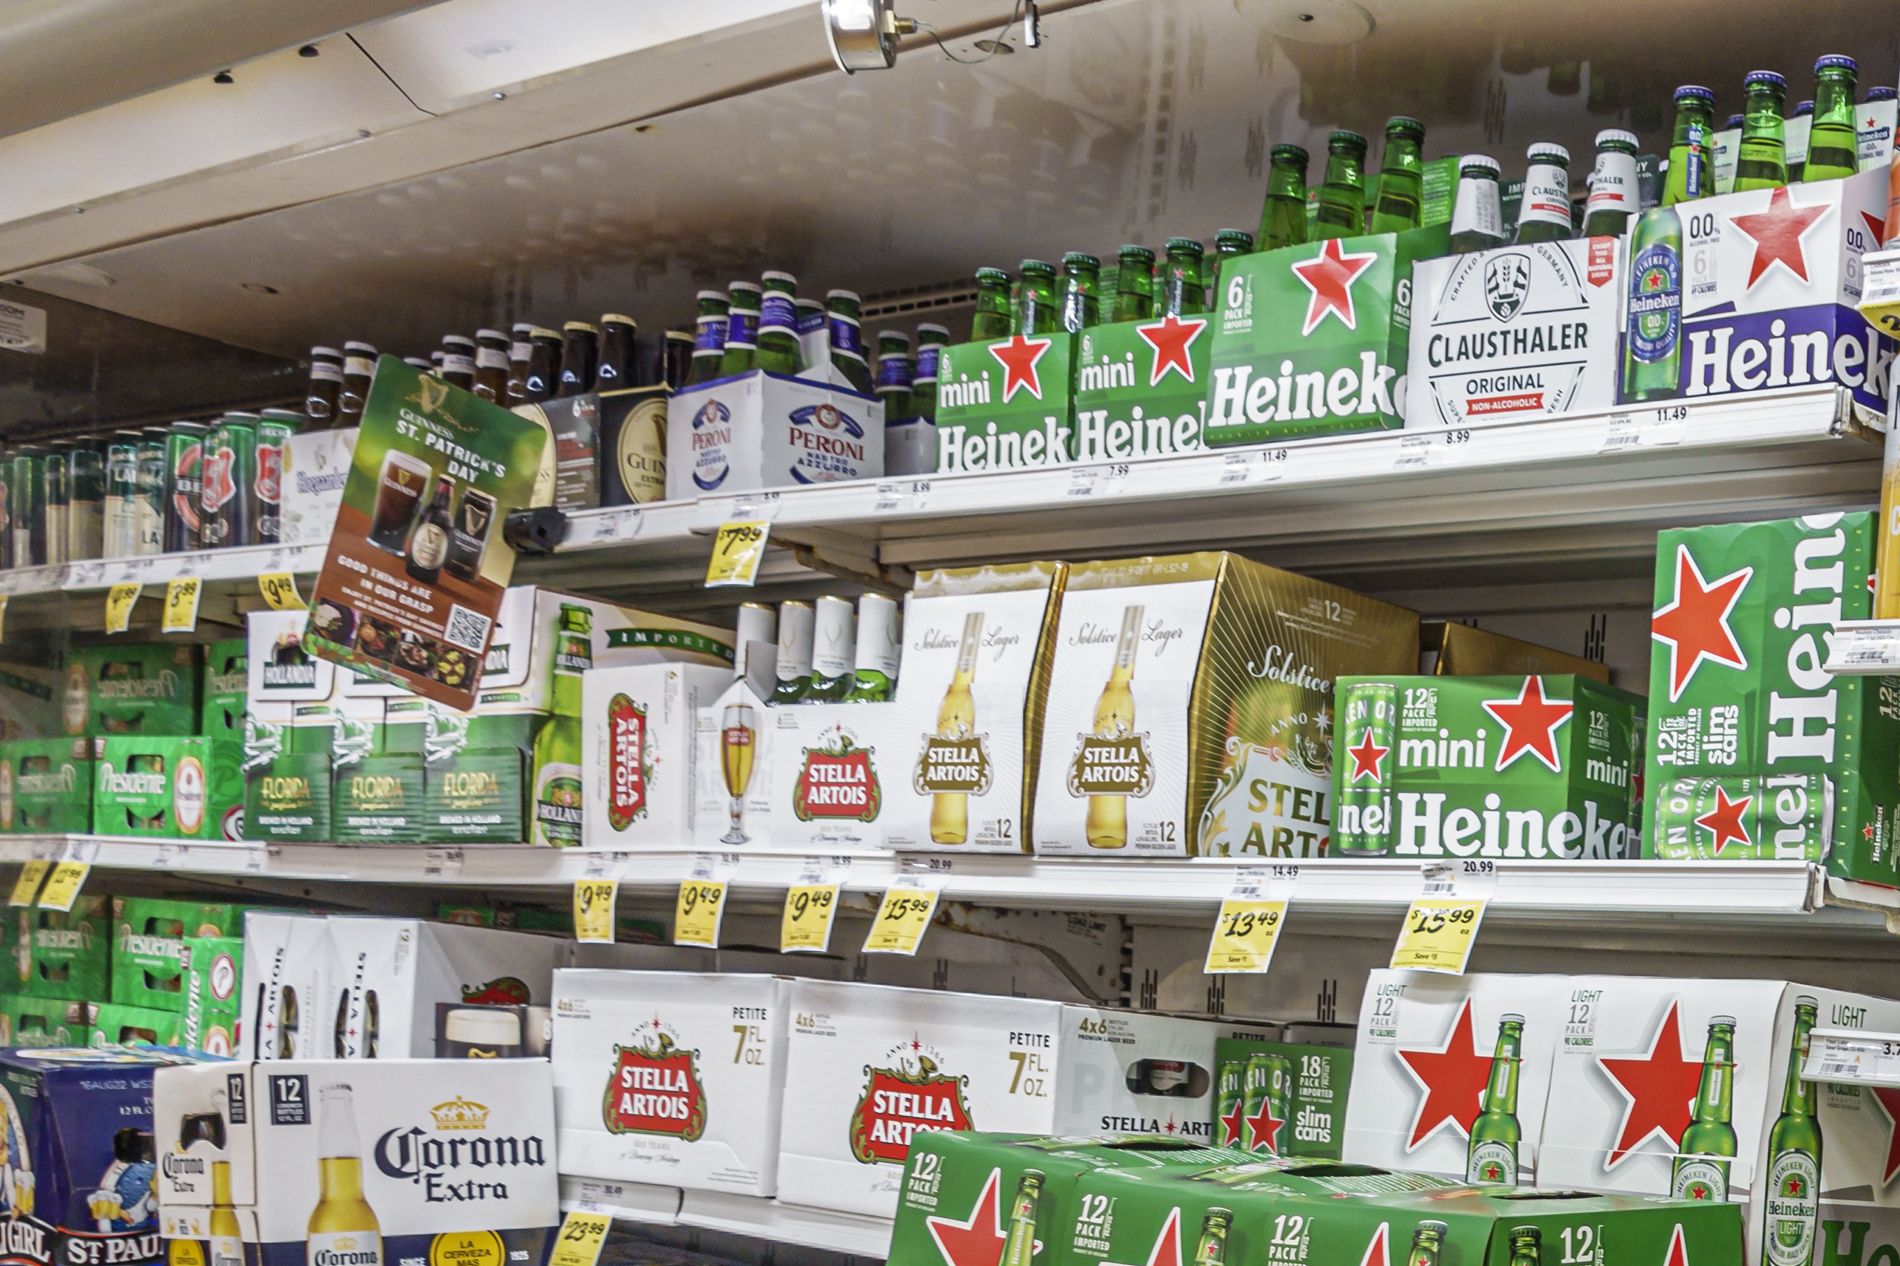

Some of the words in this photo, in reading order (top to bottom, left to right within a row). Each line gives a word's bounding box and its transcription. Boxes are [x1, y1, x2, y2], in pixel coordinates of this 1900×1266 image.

[1223, 307, 1244, 320] PACK
[1428, 321, 1589, 369] CLAUSTHALER
[1080, 352, 1136, 393] mini
[1466, 372, 1545, 397] ORIGINAL
[939, 372, 990, 408] mini
[1470, 394, 1539, 414] NON-ALCOHOLIC
[1656, 406, 1688, 424] 11.49
[399, 407, 455, 441] GUINNESS
[396, 419, 421, 442] ST.
[424, 433, 506, 479] PATRICK'S
[789, 428, 865, 462] PERONI
[1445, 431, 1471, 445] 8.99
[447, 459, 480, 484] DAY
[796, 459, 858, 480] AZZURRO
[1109, 464, 1130, 478] 7.99
[337, 555, 369, 575] GOOD
[370, 566, 410, 592] THINGS
[409, 581, 432, 601] ARE
[360, 578, 373, 591] IN
[373, 583, 398, 601] OUR
[398, 592, 435, 614] GRASP
[1402, 717, 1438, 728] IMPORTED
[1708, 705, 1725, 765] slim
[1722, 704, 1739, 766] cans
[1400, 730, 1486, 768] mini
[808, 764, 867, 785] STELLA
[807, 786, 867, 808] ARTOIS
[1462, 860, 1493, 874] 20.99
[1831, 1004, 1868, 1028] LIGHT
[1009, 1030, 1051, 1049] PETITE
[1008, 1051, 1028, 1095] 7
[1028, 1053, 1049, 1074] FL.
[1023, 1079, 1048, 1099] OZ.
[873, 1089, 955, 1122] STELLA
[1296, 1106, 1331, 1128] slim
[1295, 1124, 1331, 1144] cans
[374, 1125, 547, 1185] Corona
[424, 1172, 509, 1203] Extra
[1560, 1225, 1594, 1265] 12
